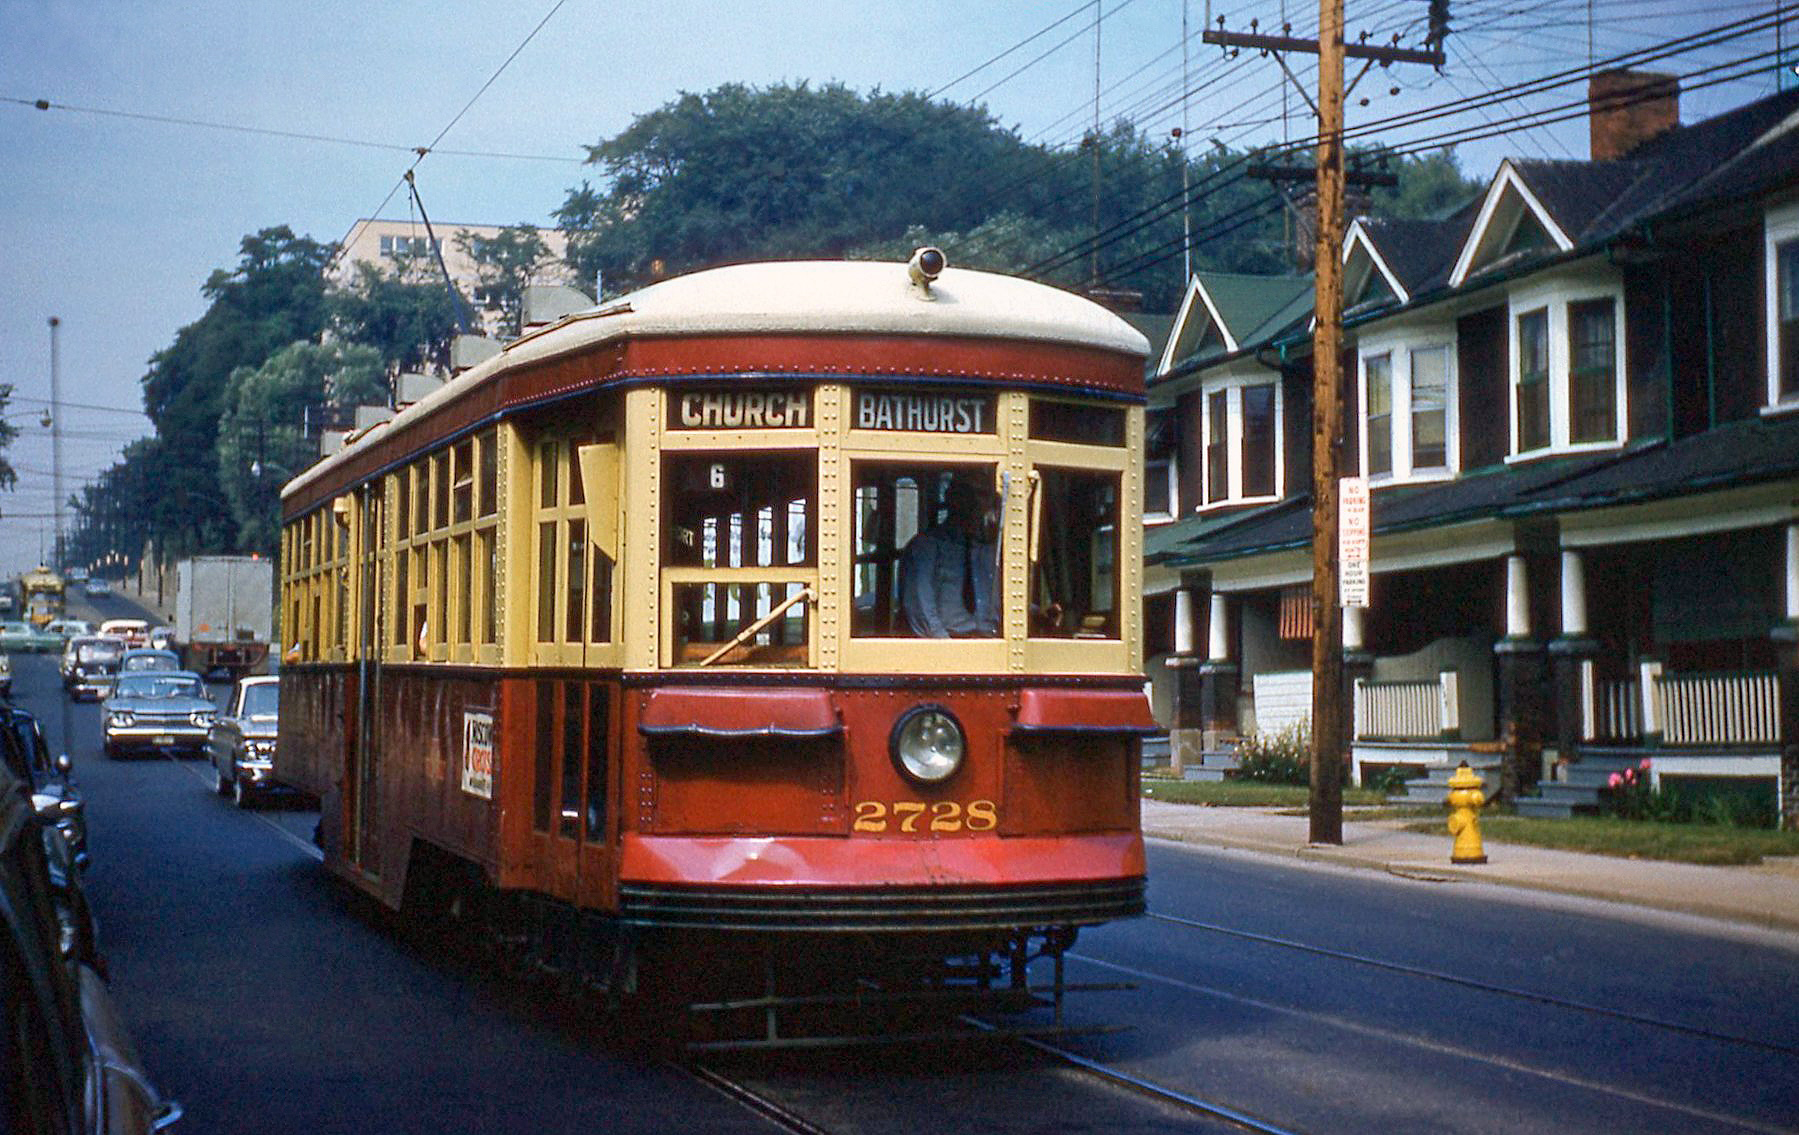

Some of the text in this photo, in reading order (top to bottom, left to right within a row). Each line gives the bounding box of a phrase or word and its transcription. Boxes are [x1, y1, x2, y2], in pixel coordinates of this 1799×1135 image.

[681, 392, 808, 427] CHURCH
[859, 393, 986, 432] BATHURST
[710, 463, 725, 489] 6
[1348, 486, 1360, 494] NO
[1348, 518, 1360, 526] NO
[1348, 561, 1361, 569] ONE
[853, 799, 999, 833] 2728
